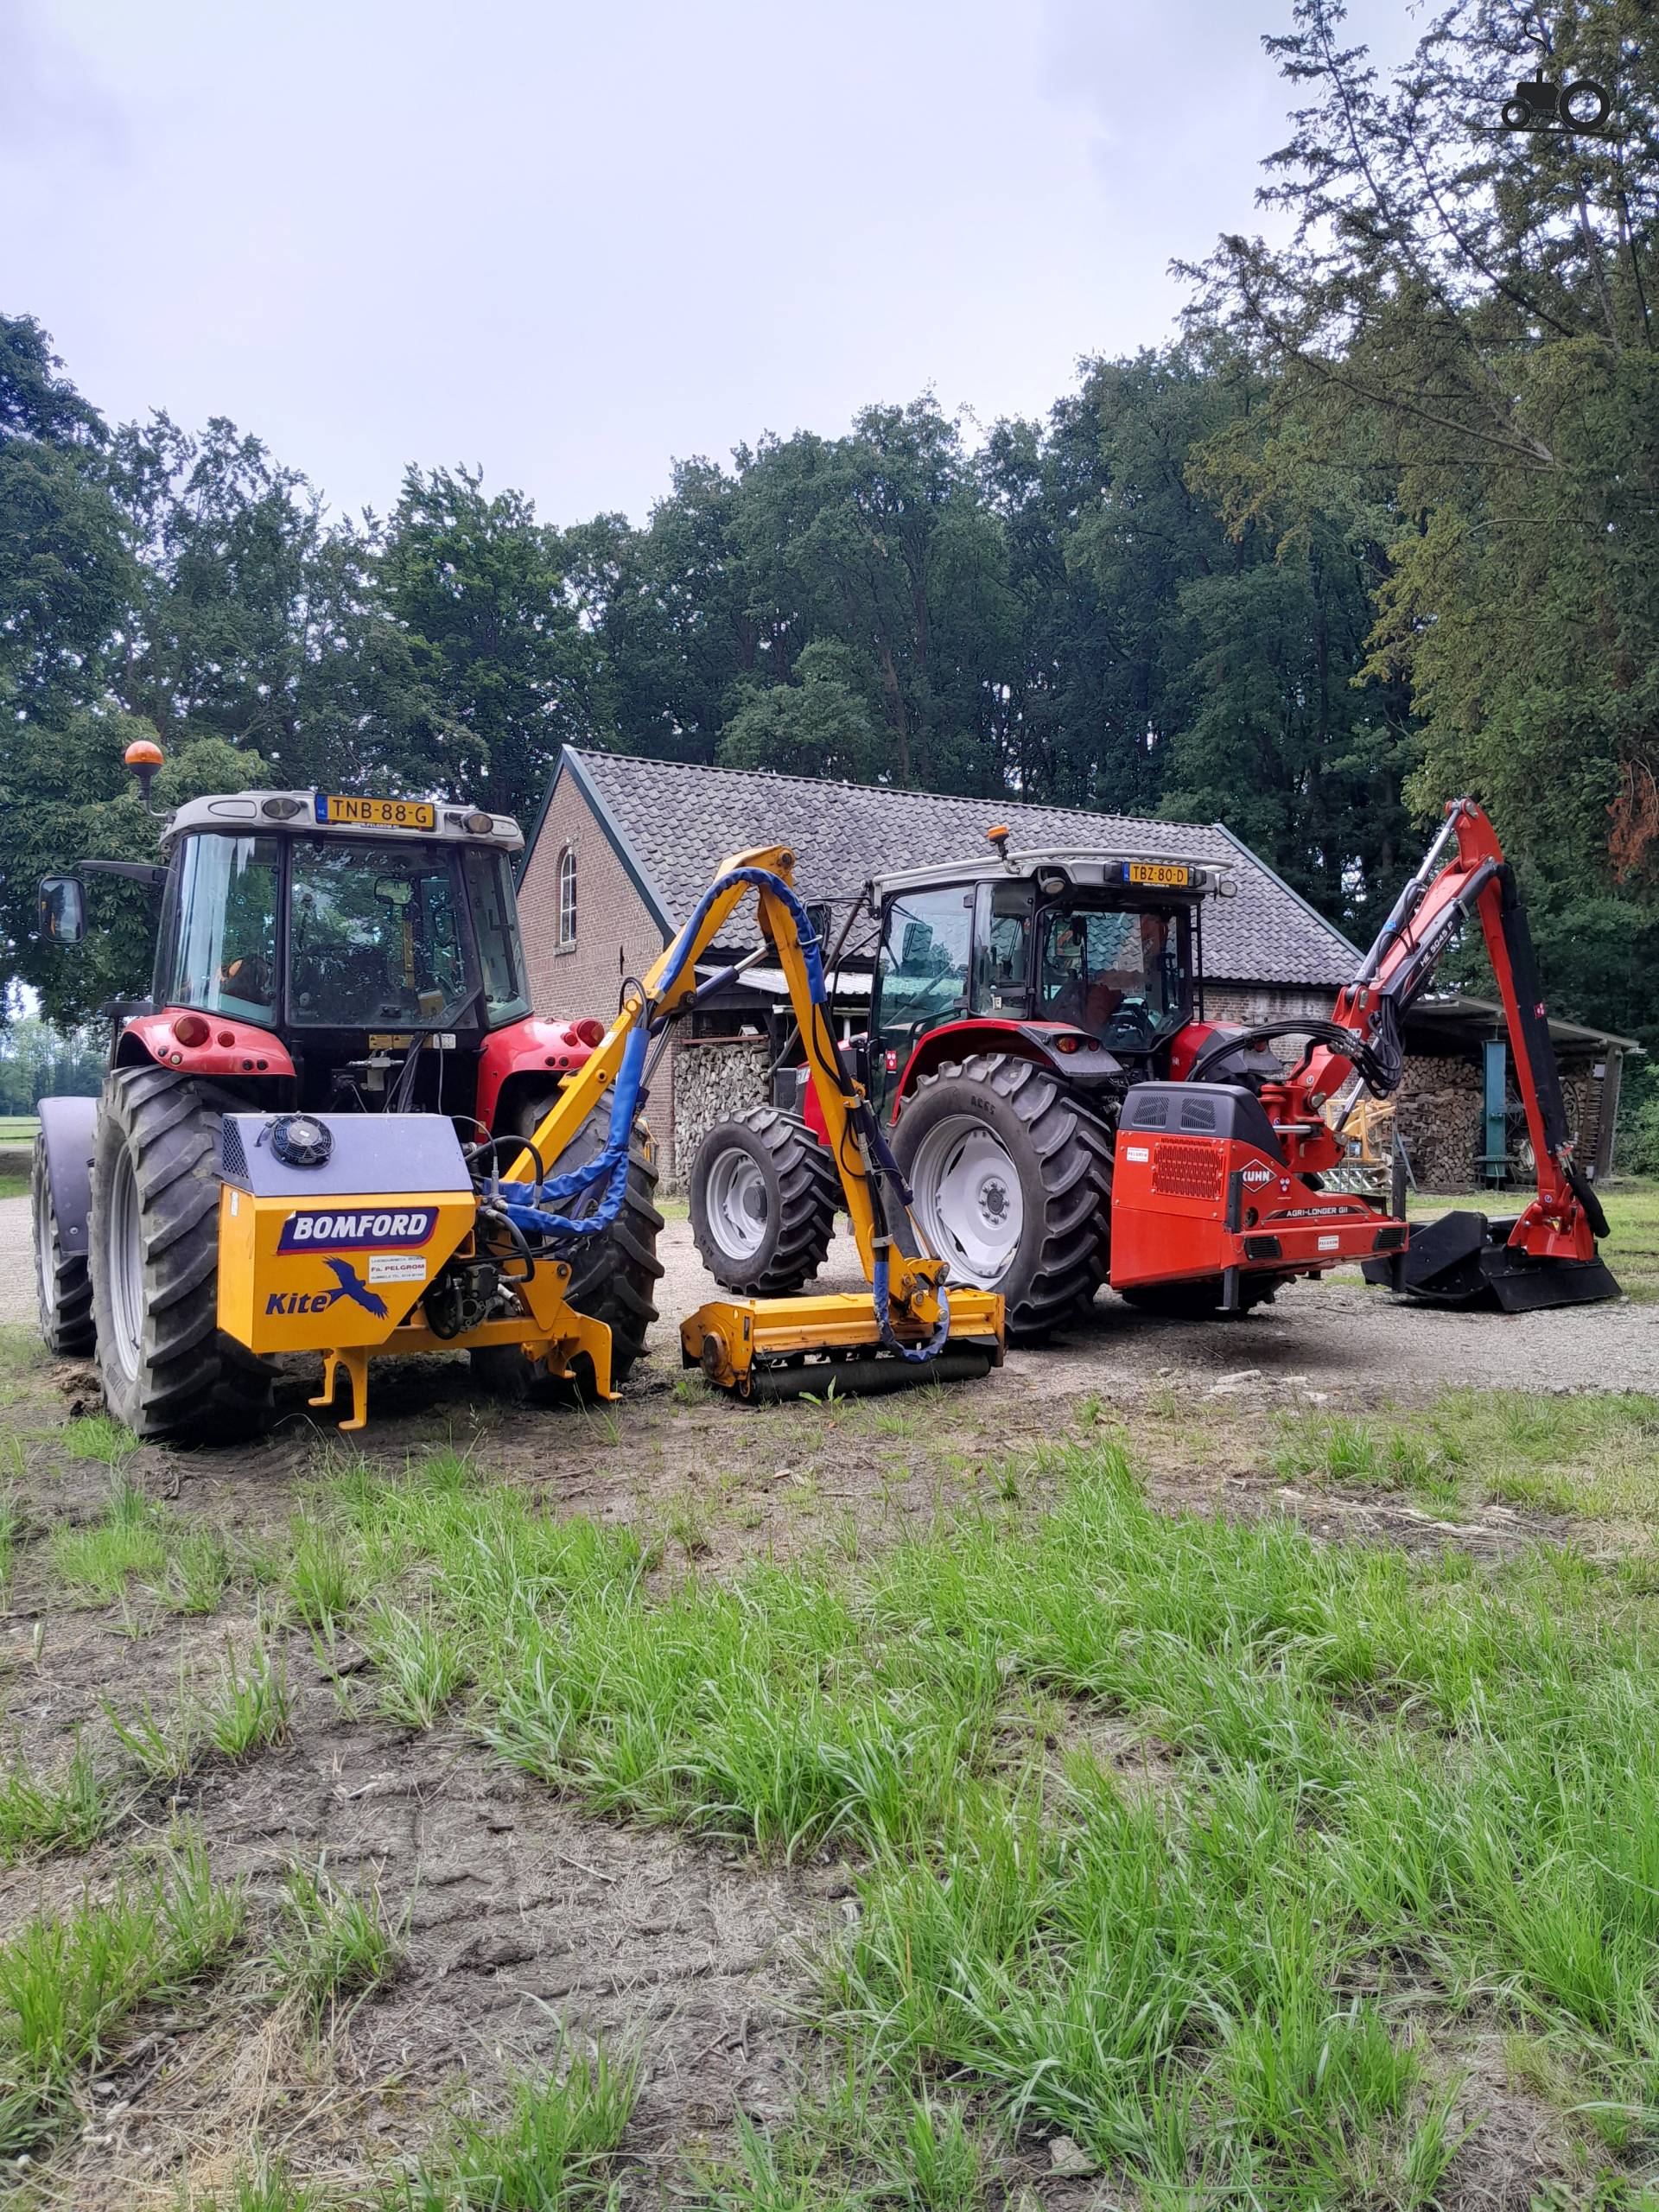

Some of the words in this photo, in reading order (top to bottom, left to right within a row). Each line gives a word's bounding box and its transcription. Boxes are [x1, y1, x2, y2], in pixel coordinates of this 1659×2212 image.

[333, 799, 428, 823] TNB-88-G
[1133, 866, 1184, 882] TBZ-80-D
[1420, 952, 1431, 967] HE
[1430, 929, 1448, 954] 5045
[1447, 920, 1453, 931] P
[1287, 1207, 1337, 1217] AGRI-LONGER
[292, 1213, 429, 1241] BOMFORD
[384, 1263, 425, 1272] PELGROM
[264, 1293, 328, 1315] Kite
